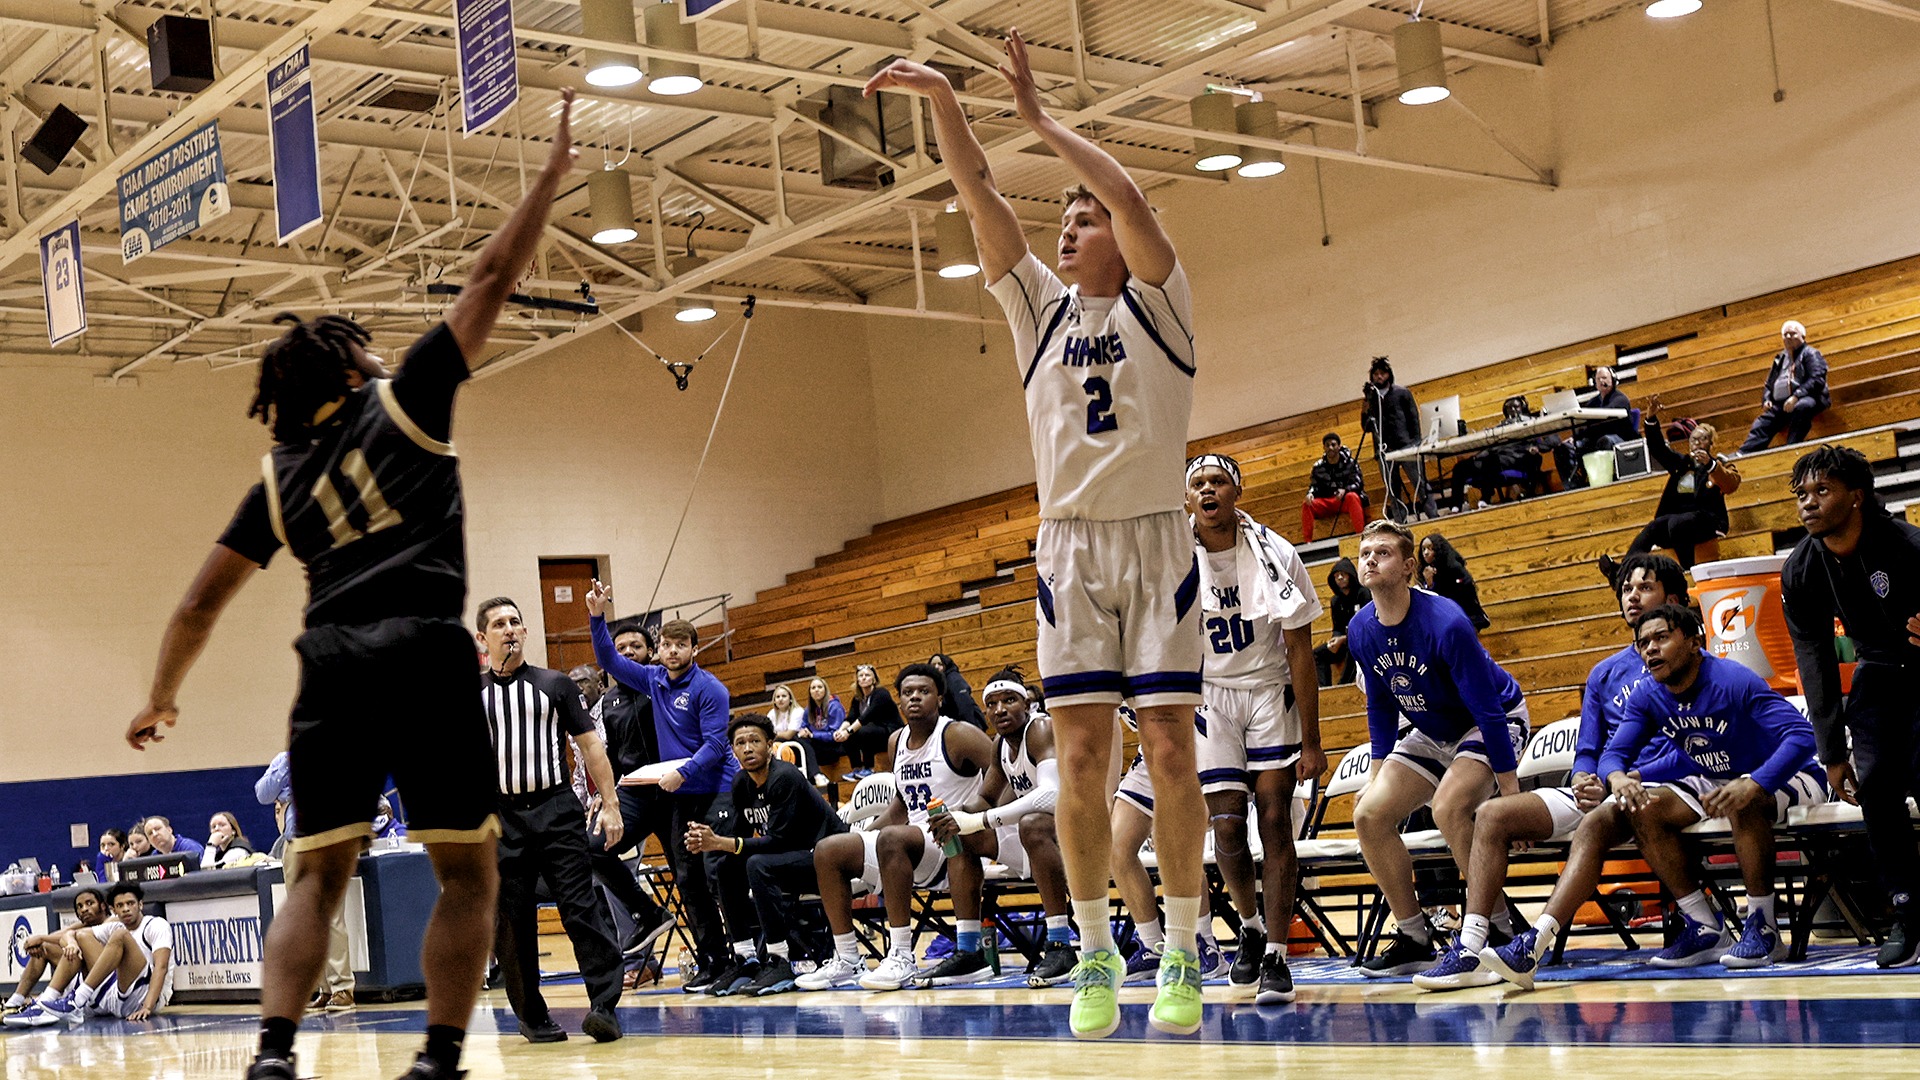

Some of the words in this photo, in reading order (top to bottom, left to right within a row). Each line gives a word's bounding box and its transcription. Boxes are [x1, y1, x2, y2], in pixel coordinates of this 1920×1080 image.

[122, 169, 143, 198] CIAA
[144, 152, 171, 185] MOST
[172, 125, 216, 169] POSITIVE
[124, 190, 150, 223] GAME
[150, 151, 218, 207] ENVIRONMENT
[148, 192, 191, 232] 2010-2011
[56, 257, 70, 291] 23
[1062, 331, 1127, 367] HAWKS
[1082, 376, 1118, 435] 2
[310, 448, 403, 549] 11
[1206, 613, 1255, 654] 20
[1714, 641, 1750, 654] SERIES
[1373, 652, 1428, 677] CHOWAN
[1532, 728, 1578, 760] CHOW
[901, 761, 932, 780] HAWKS
[1340, 752, 1371, 780] CHO
[904, 783, 933, 811] 33
[146, 865, 160, 880] POSS
[170, 916, 264, 967] UNIVERSITY
[188, 972, 207, 985] Home
[208, 971, 214, 985] of
[214, 971, 225, 985] the
[225, 970, 251, 984] HAWKS
